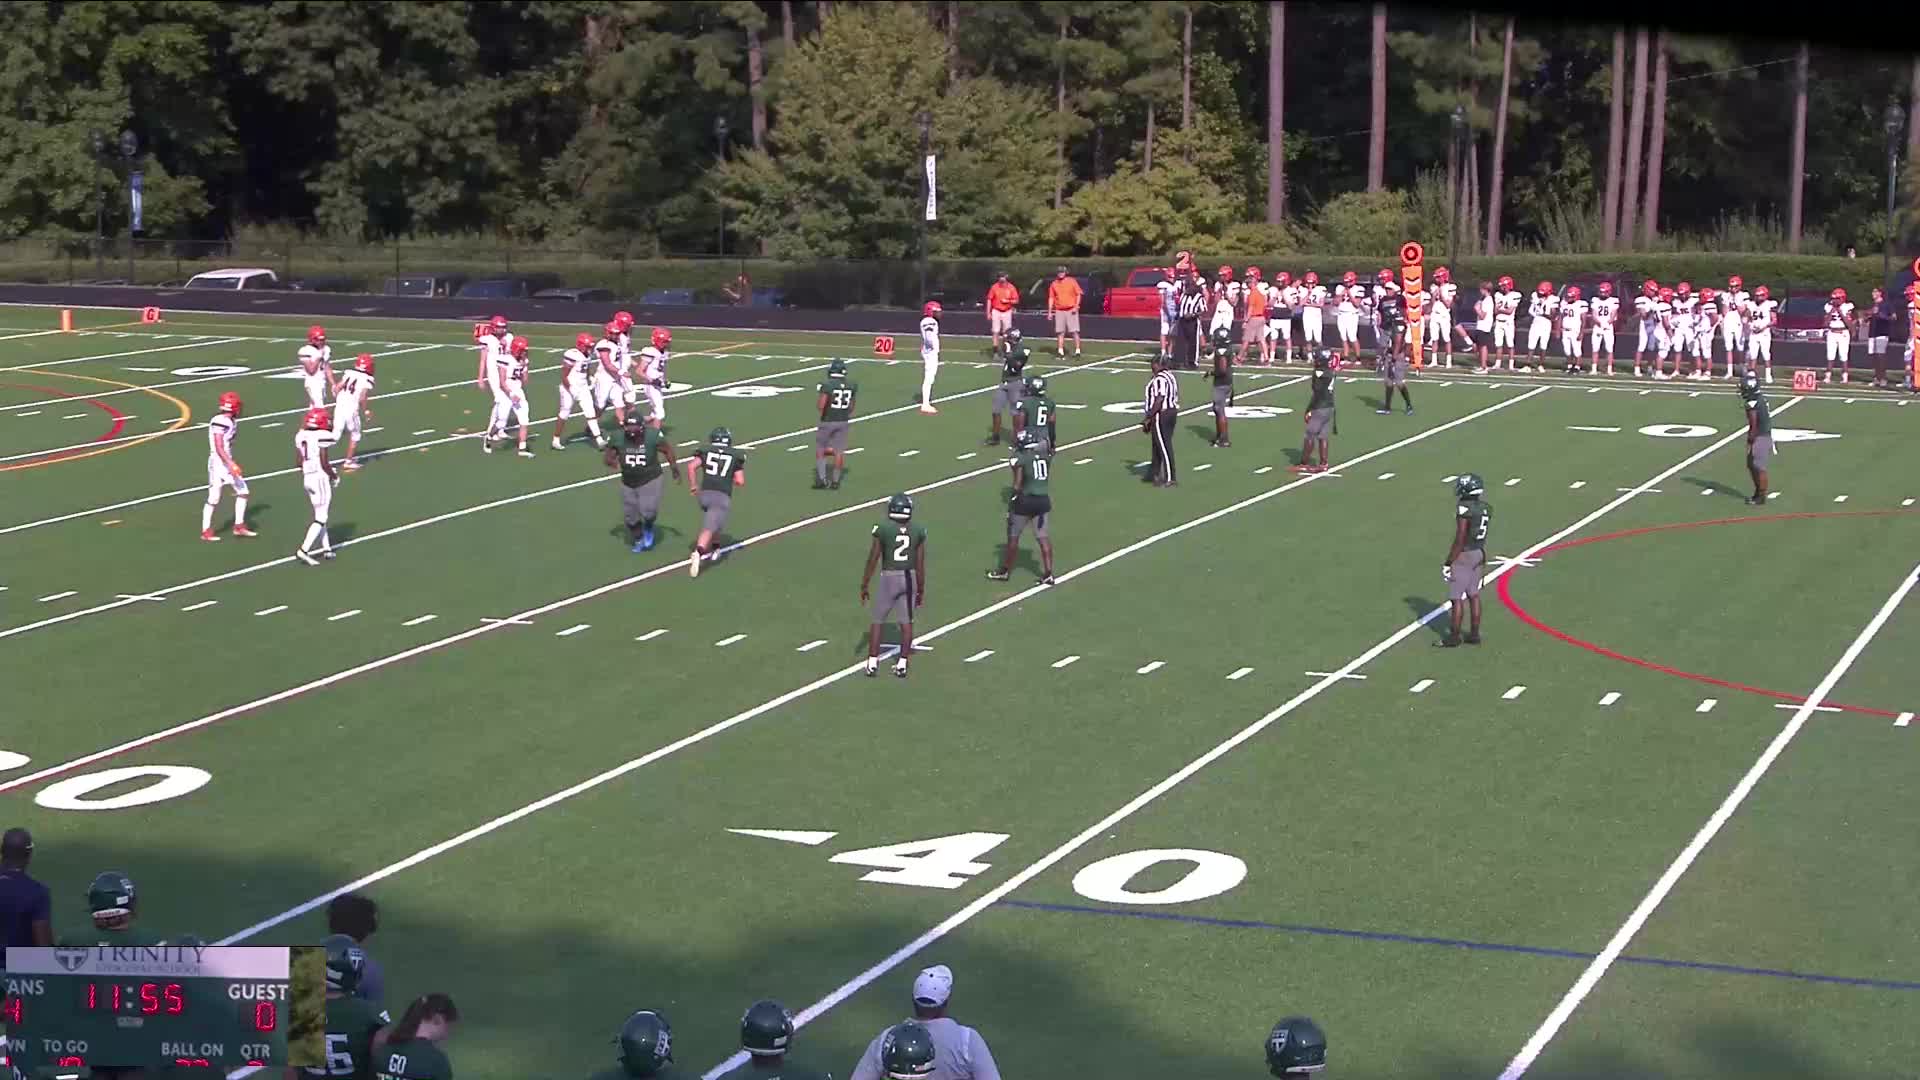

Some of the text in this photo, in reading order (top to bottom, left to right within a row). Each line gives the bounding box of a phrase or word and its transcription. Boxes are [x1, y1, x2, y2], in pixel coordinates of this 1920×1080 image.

[146, 308, 155, 321] G
[874, 339, 893, 353] 20
[1795, 373, 1815, 388] 40
[831, 388, 852, 409] 33
[1036, 406, 1048, 426] 6
[705, 451, 733, 477] 57
[1032, 459, 1048, 480] 10
[1475, 515, 1489, 540] 5
[893, 534, 910, 562] 2
[388, 1053, 407, 1075] GO
